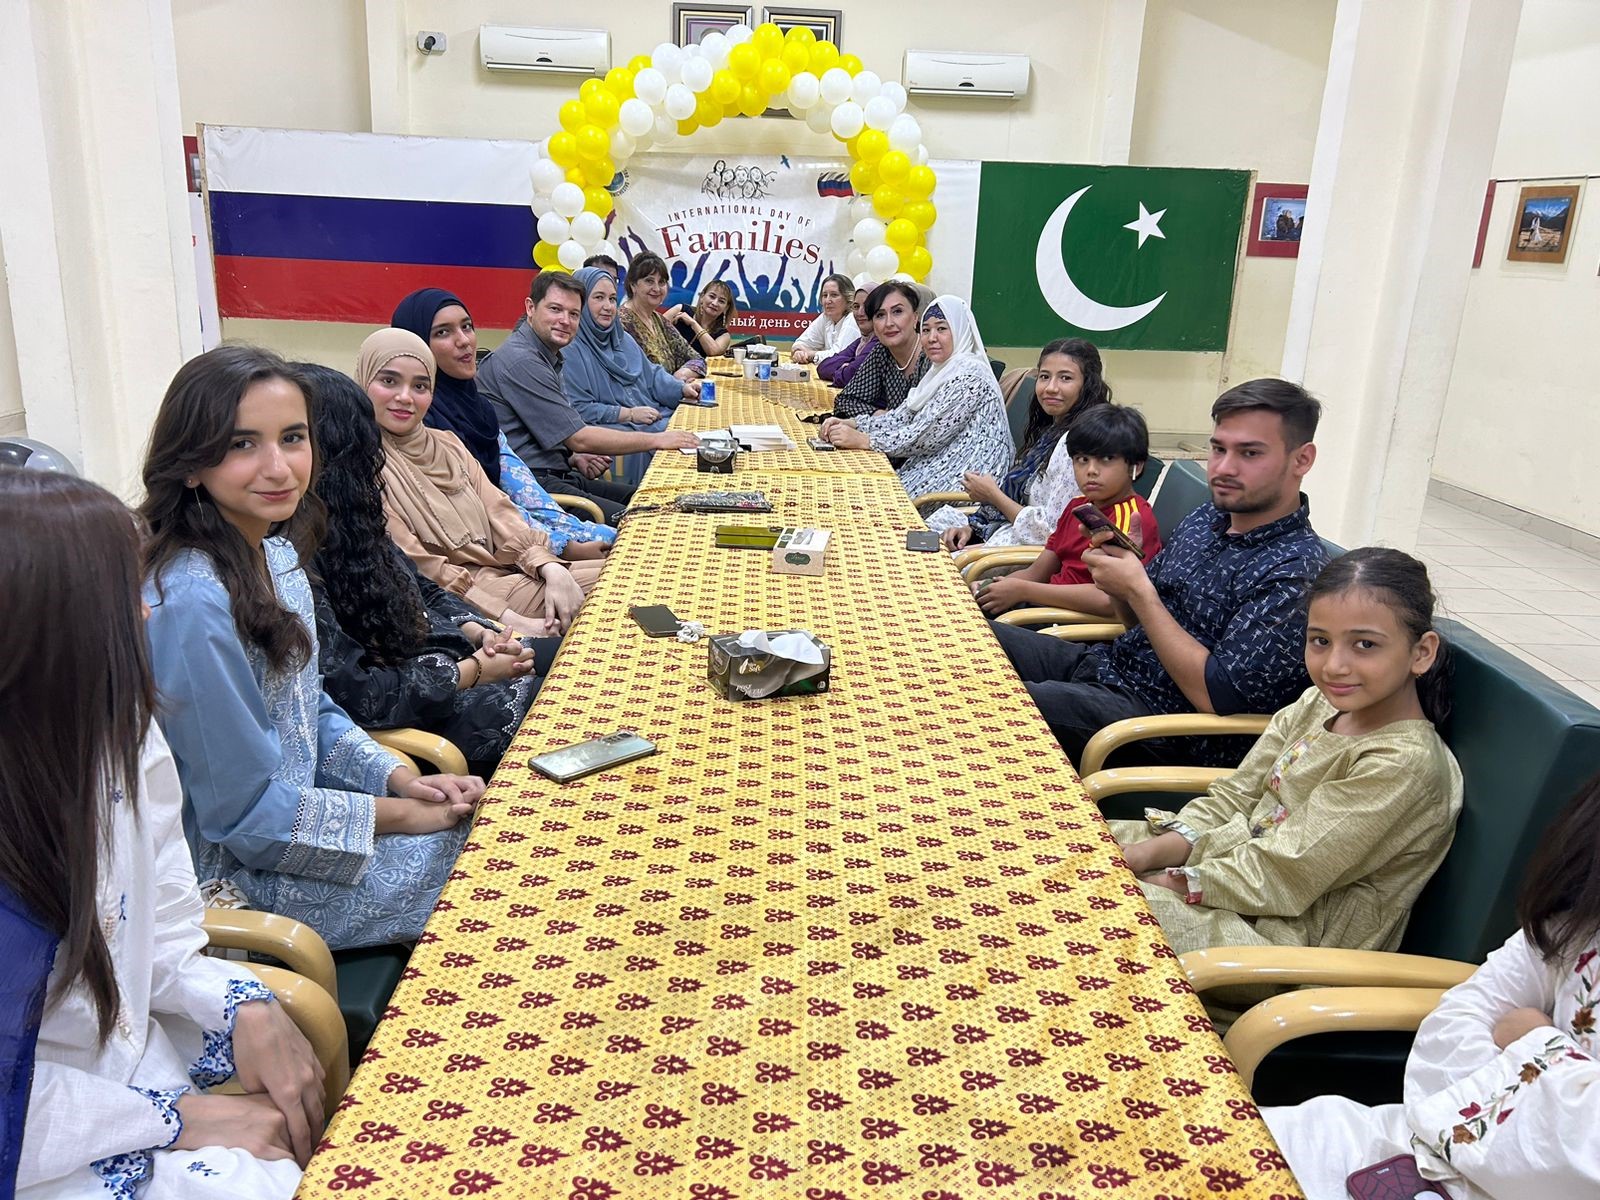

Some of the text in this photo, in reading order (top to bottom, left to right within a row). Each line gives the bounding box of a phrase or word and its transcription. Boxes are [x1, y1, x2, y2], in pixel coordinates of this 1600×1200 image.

[668, 204, 811, 227] INTERNATIONAL DAY OF
[655, 220, 820, 264] Families
[759, 318, 791, 329] день
